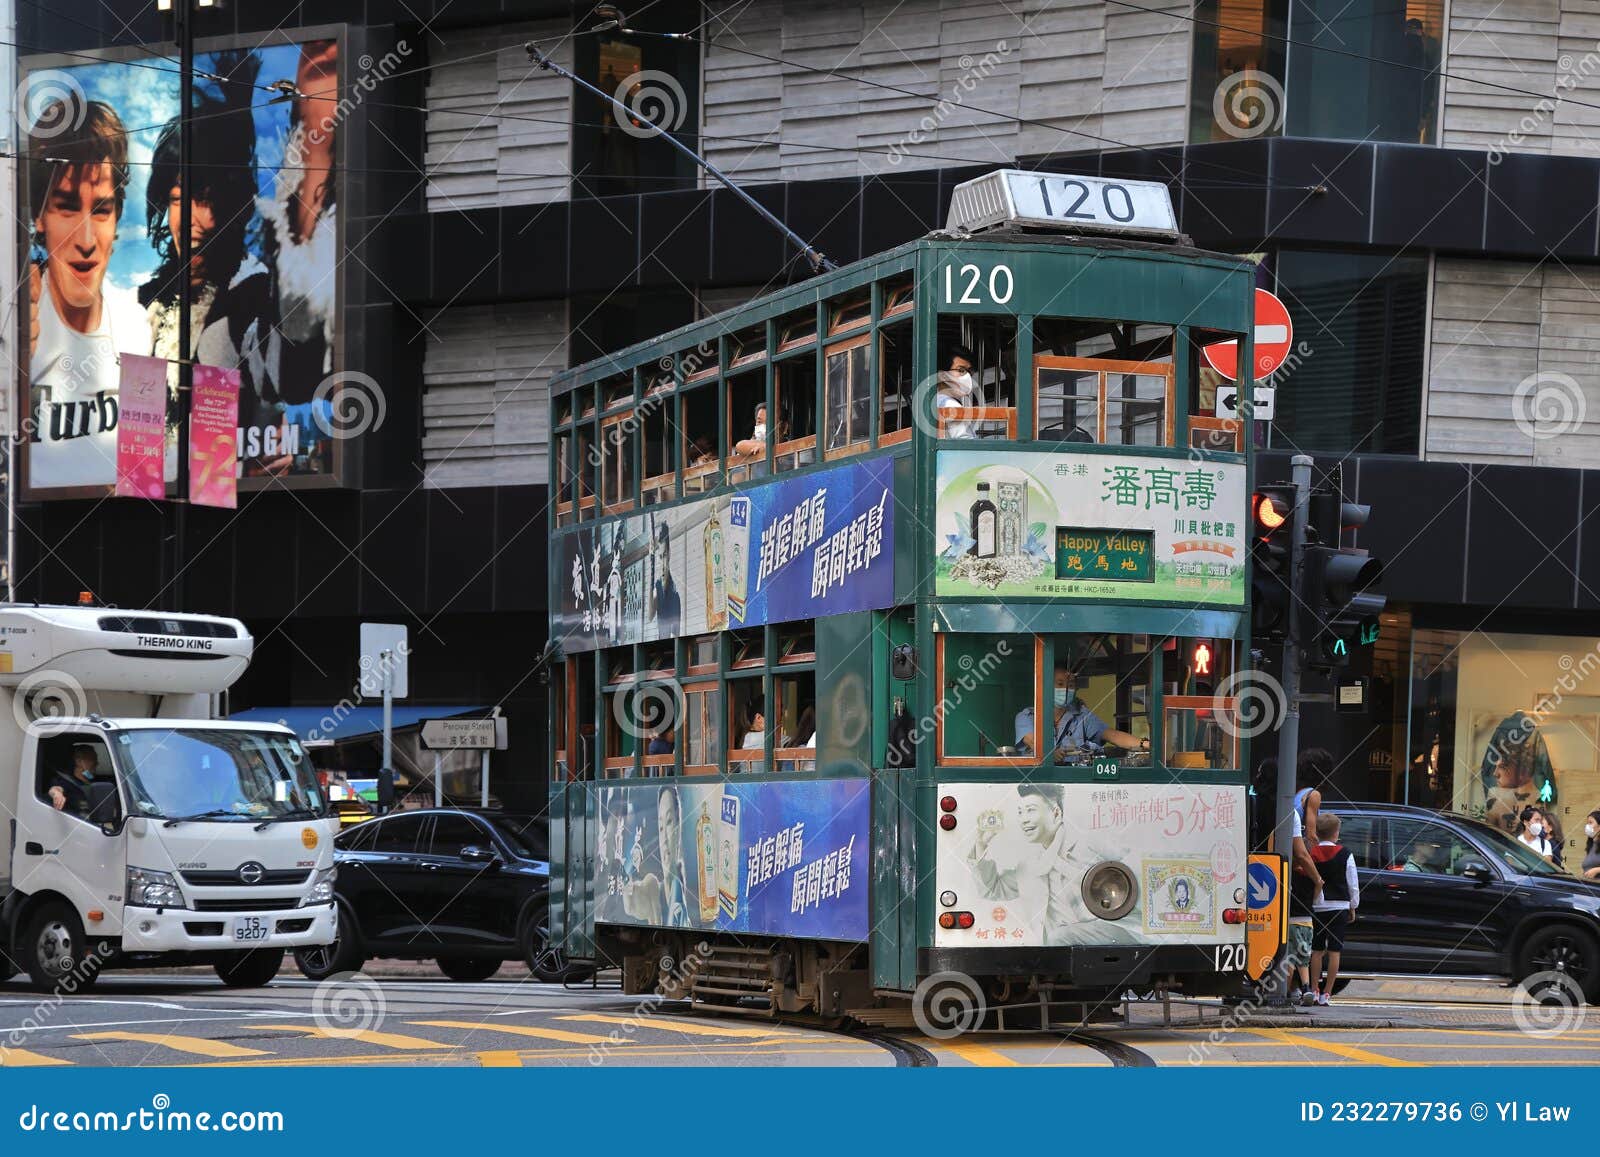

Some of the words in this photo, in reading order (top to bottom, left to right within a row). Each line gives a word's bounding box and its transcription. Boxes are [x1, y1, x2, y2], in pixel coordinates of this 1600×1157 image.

[1038, 177, 1135, 223] 120
[945, 263, 1014, 304] 120
[1054, 464, 1089, 477] 香港
[1058, 533, 1100, 556] Happy
[1105, 535, 1146, 556] Valley
[1066, 555, 1138, 572] 跑馬地
[137, 635, 184, 649] THERMO
[186, 638, 213, 650] KING
[1096, 763, 1118, 775] 049
[244, 917, 260, 929] TS
[236, 928, 267, 939] 9207
[1214, 944, 1247, 972] 120
